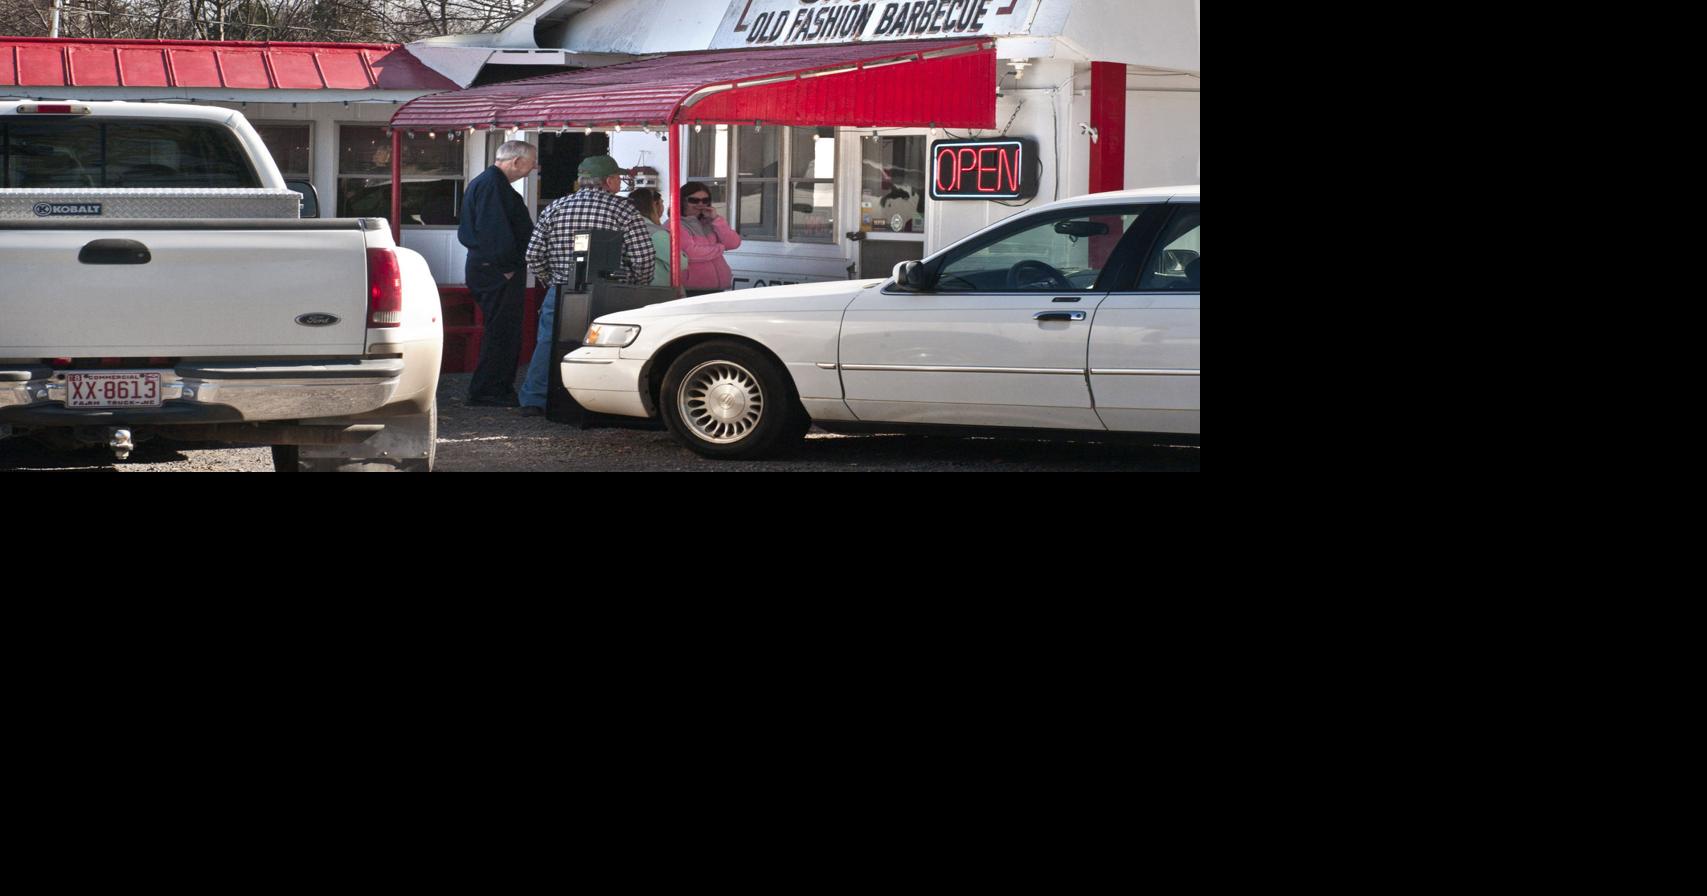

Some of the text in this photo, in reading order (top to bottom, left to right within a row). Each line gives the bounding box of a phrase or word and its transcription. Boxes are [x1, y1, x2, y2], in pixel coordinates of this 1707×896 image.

[746, 0, 990, 44] OLD FASHION BARBECUE
[936, 147, 1020, 192] OPEN
[52, 205, 100, 214] KOBALT
[72, 380, 157, 400] XX-8613
